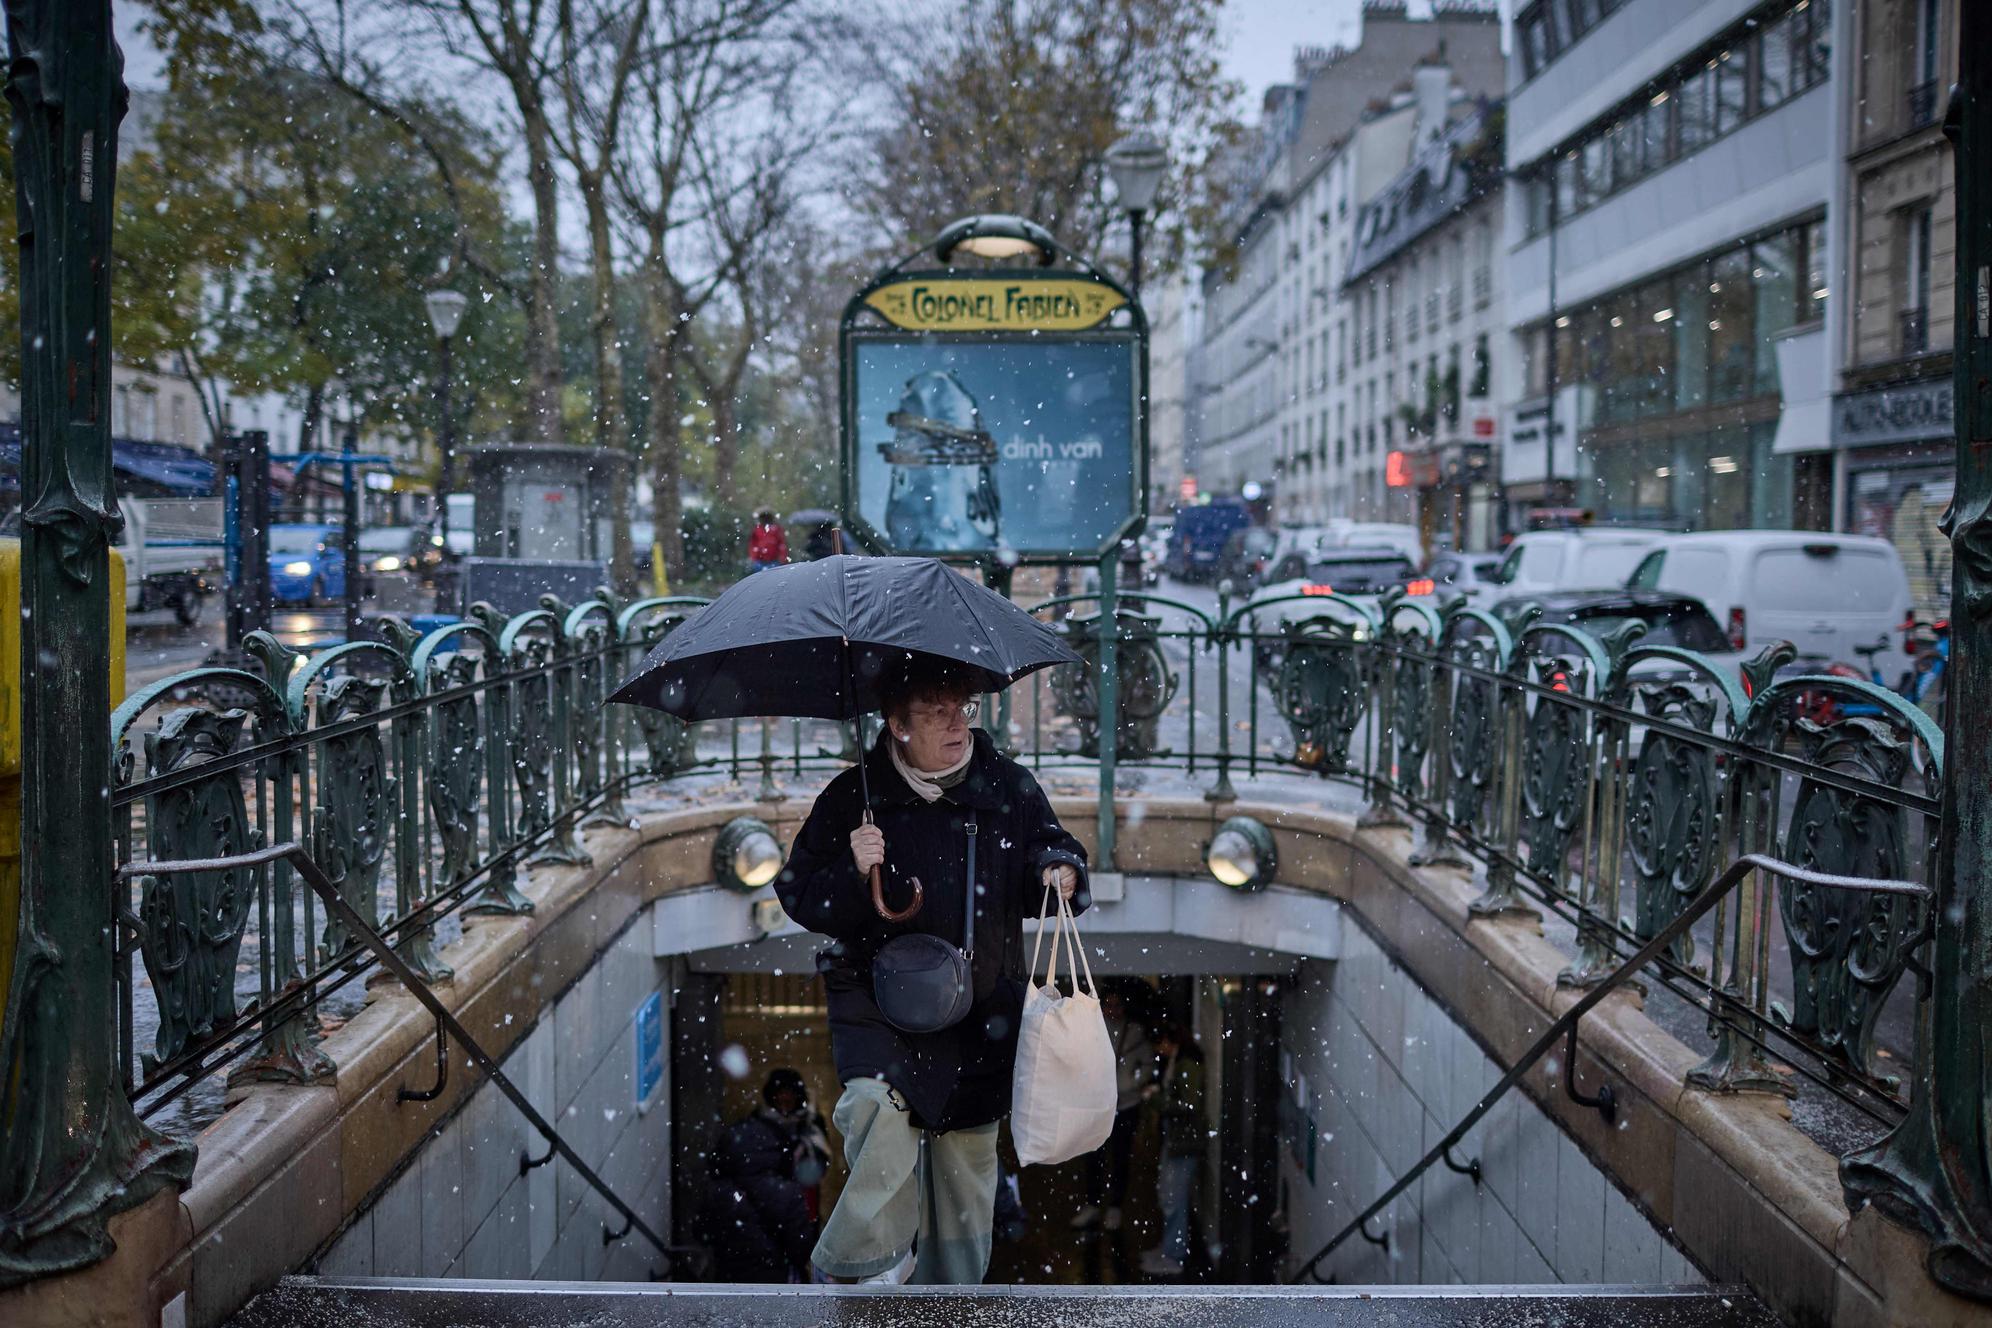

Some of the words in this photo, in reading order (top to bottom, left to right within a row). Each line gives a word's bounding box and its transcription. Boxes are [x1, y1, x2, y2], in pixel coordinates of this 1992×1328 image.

[911, 287, 1000, 323] COLONEL
[1005, 286, 1081, 322] FABIEN
[1003, 433, 1053, 459] dinh
[1060, 440, 1104, 459] van
